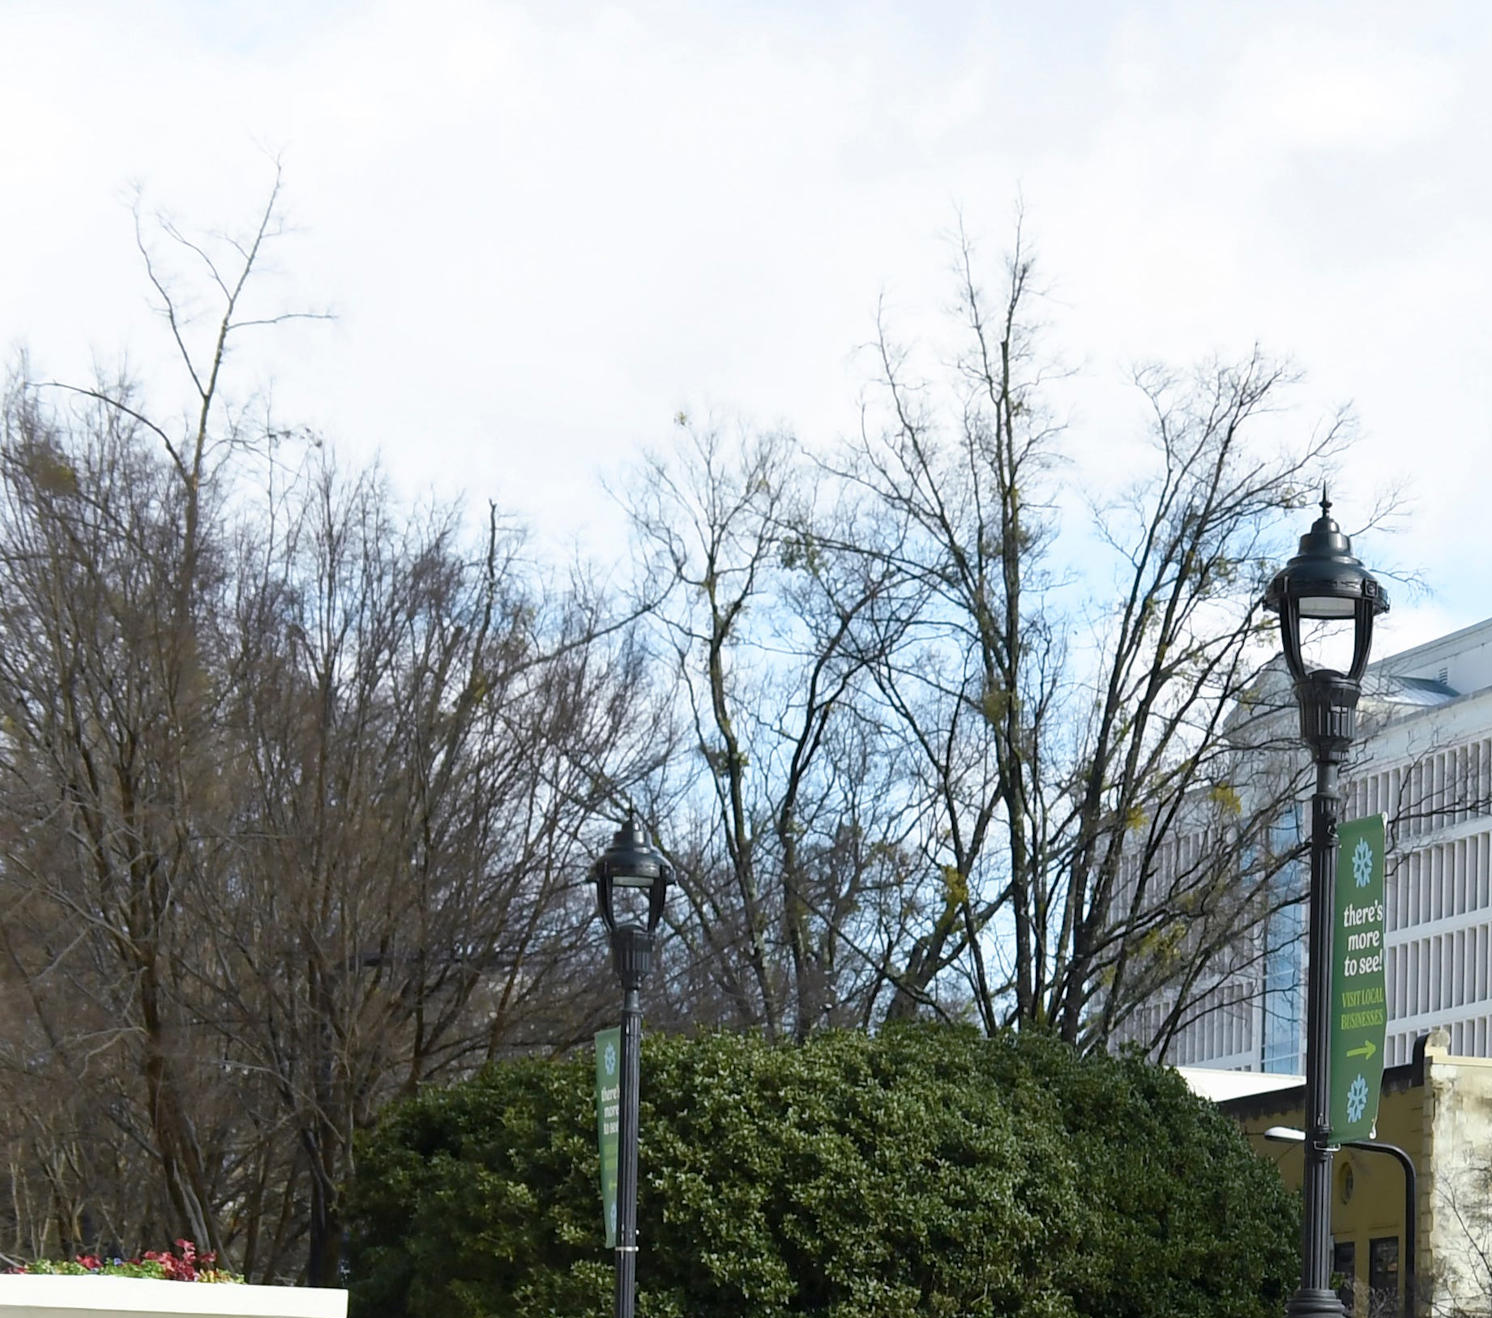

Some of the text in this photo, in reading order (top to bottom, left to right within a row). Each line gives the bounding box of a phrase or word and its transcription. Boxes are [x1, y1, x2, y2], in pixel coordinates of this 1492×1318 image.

[1343, 899, 1383, 928] there's
[1348, 930, 1380, 951] more
[1344, 948, 1382, 976] to see!
[1342, 987, 1384, 1008] VISIT LOCAL
[1341, 1009, 1384, 1030] BUSINESSES
